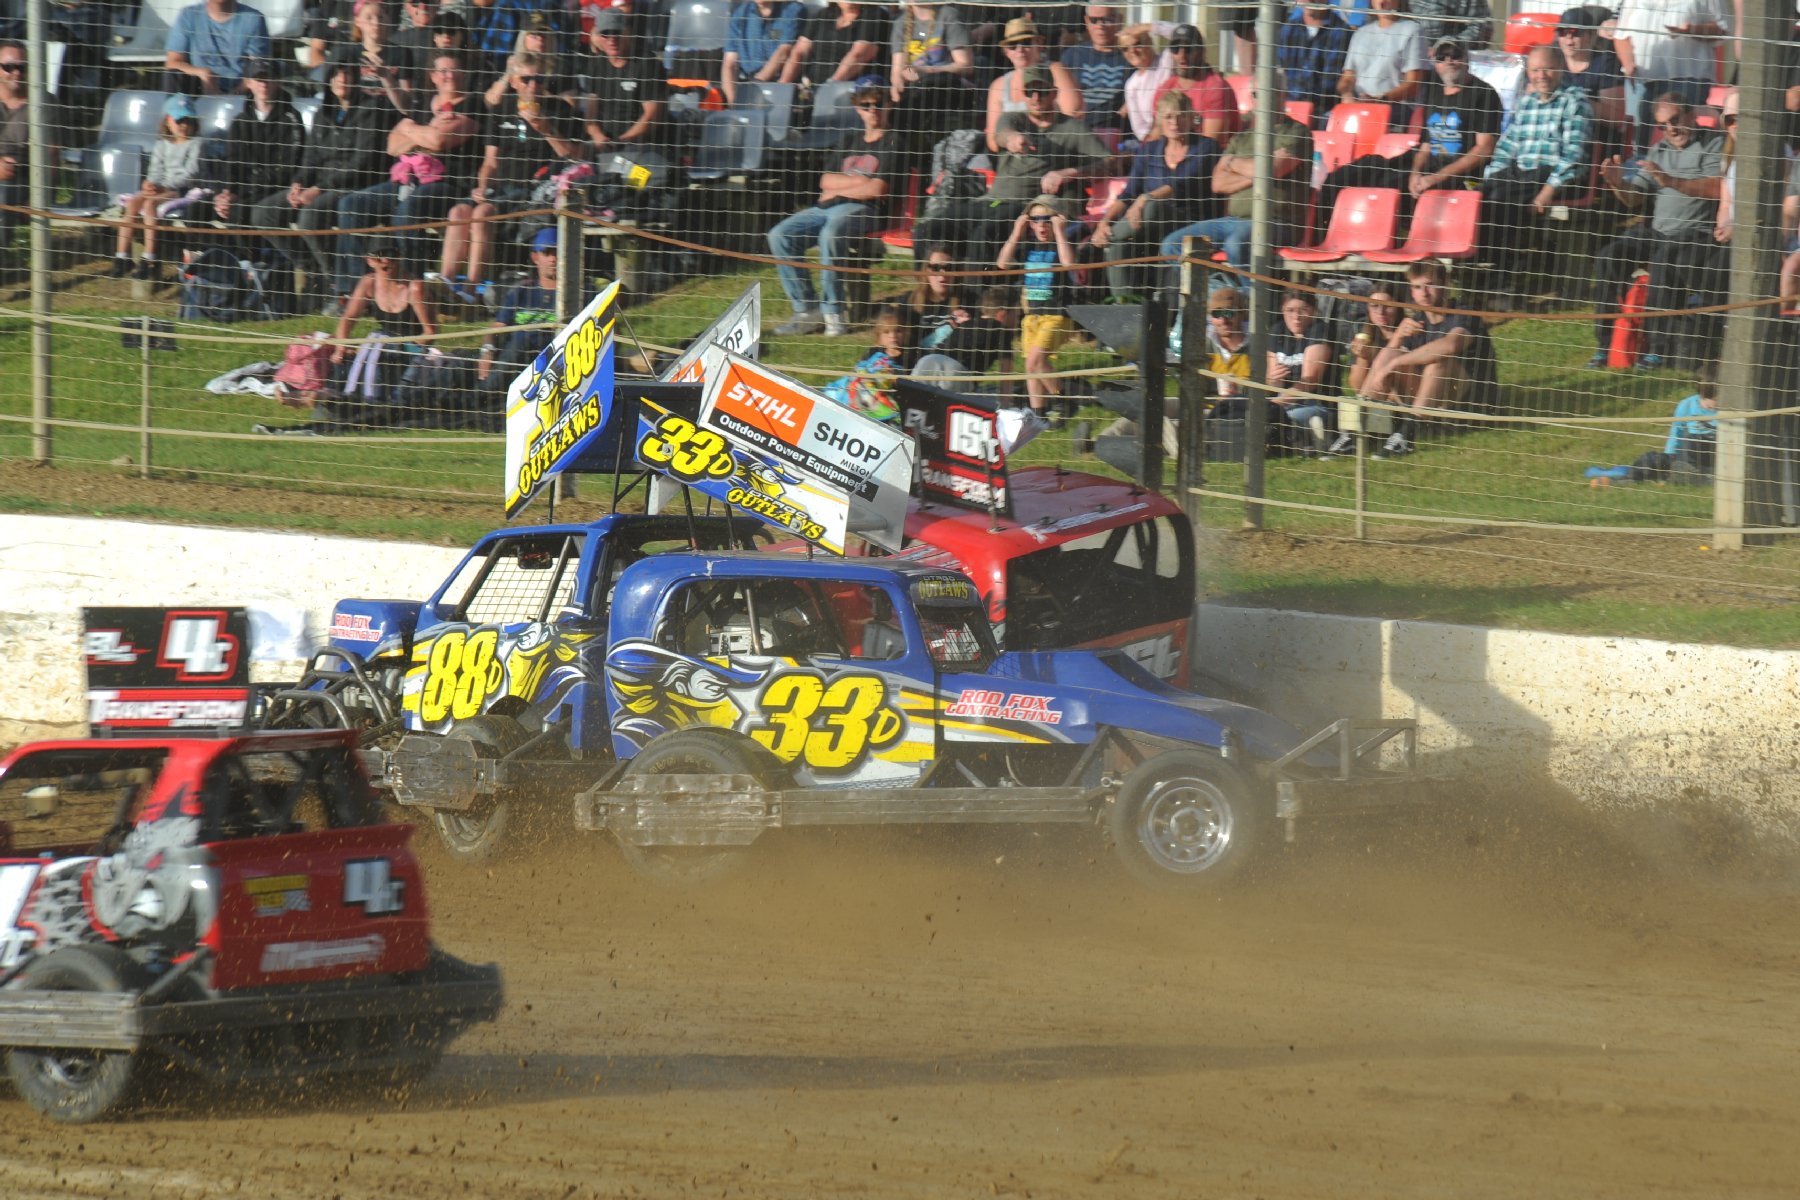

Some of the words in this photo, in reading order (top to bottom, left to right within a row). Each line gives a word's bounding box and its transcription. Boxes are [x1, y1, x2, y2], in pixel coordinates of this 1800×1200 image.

[565, 318, 602, 390] 88D
[726, 382, 797, 428] STIHL
[519, 396, 599, 494] OUTLAWS
[642, 417, 732, 475] 33D
[719, 414, 767, 443] Outdoor
[767, 437, 806, 462] Power
[805, 456, 868, 494] Equipment
[813, 421, 881, 463] SHOP
[840, 458, 873, 480] MILTON
[727, 487, 826, 540] OUTLAWS
[918, 579, 969, 600] OUTLAWS
[420, 630, 503, 723] 88D
[1007, 694, 1056, 711] FOX
[750, 675, 901, 768] 33D
[945, 703, 1062, 724] CONTRACTING
